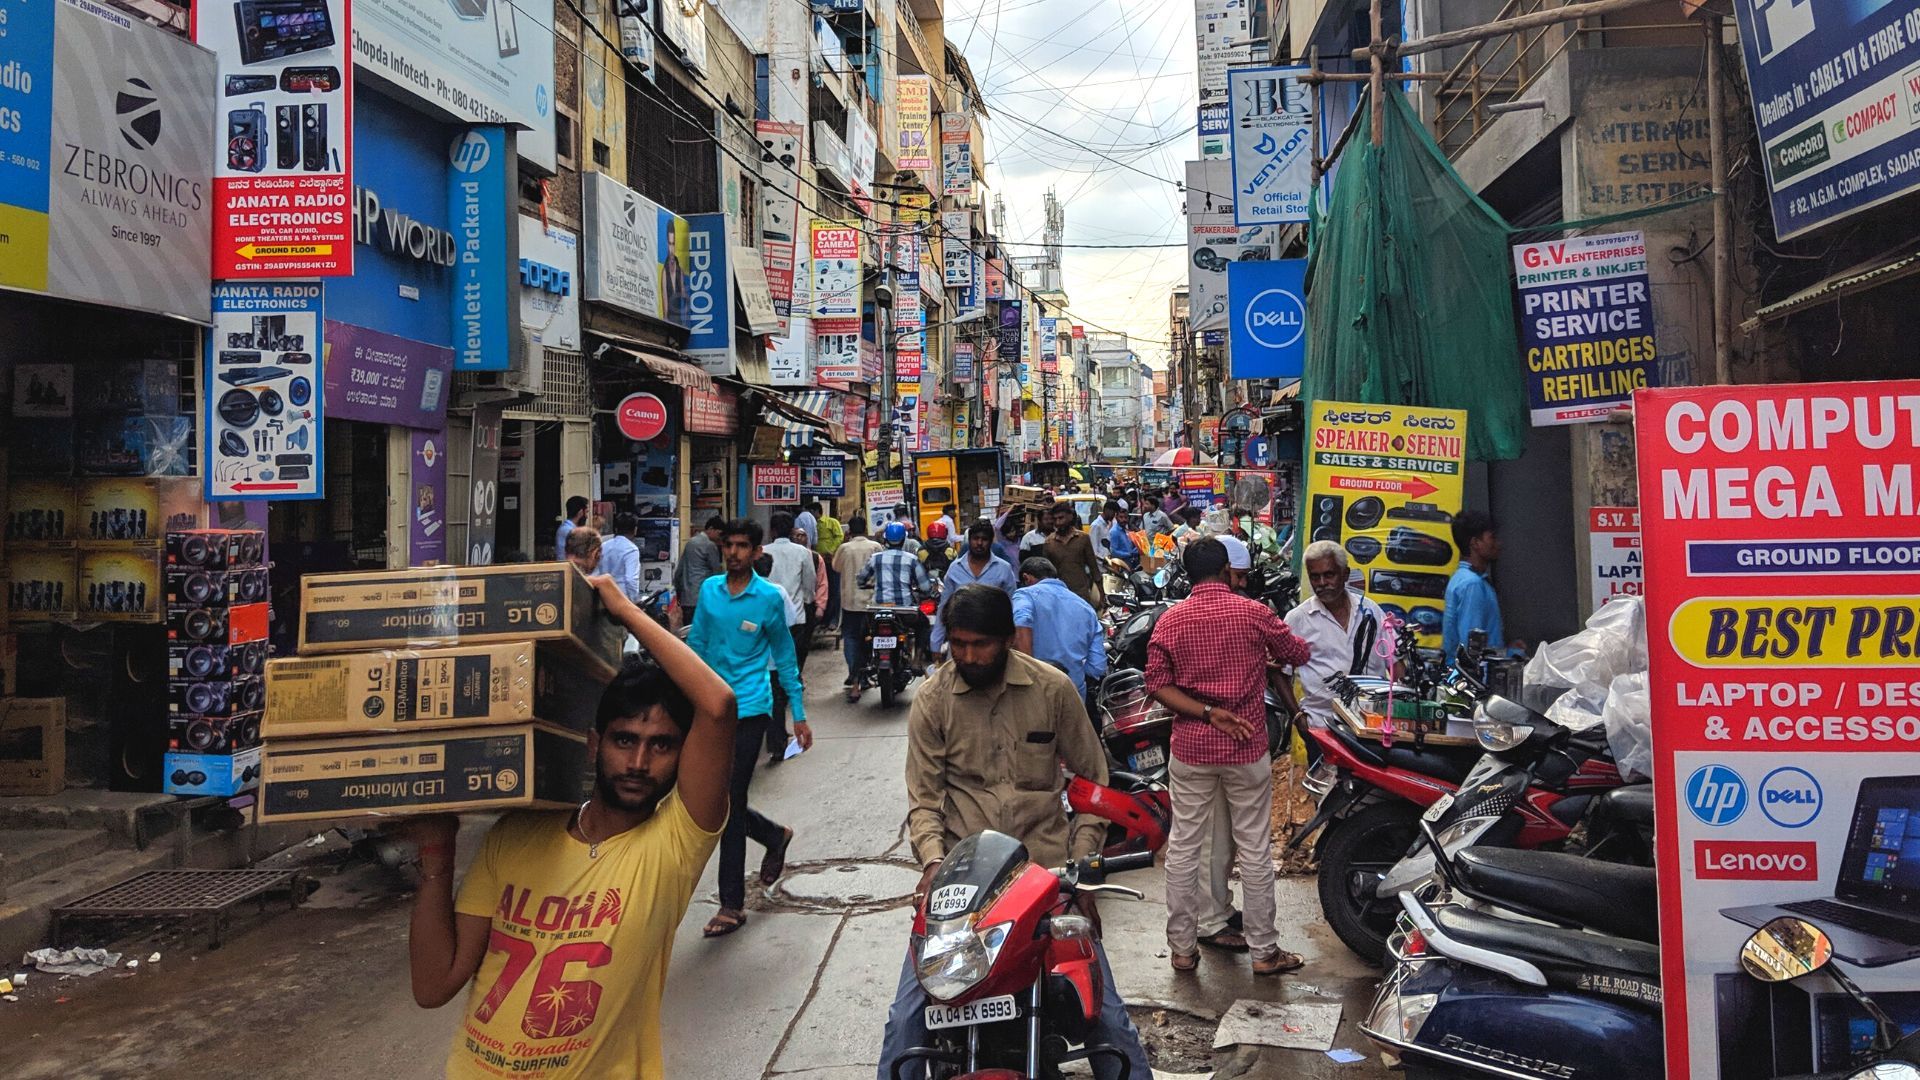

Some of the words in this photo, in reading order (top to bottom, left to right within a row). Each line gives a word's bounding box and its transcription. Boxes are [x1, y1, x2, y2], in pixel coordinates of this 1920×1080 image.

[352, 28, 388, 67] Chopda
[391, 51, 429, 90] Infotech
[437, 78, 451, 102] Ph:
[452, 88, 468, 110] 080
[469, 97, 488, 122] 4215
[1759, 92, 1794, 127] Dealers
[1792, 82, 1805, 109] in
[1810, 55, 1845, 99] CABLE
[1843, 48, 1858, 80] TV
[1858, 42, 1870, 72] &
[1868, 18, 1906, 66] FIBRE
[896, 88, 928, 96] S.M.D
[1201, 109, 1229, 119] PRINT
[1846, 92, 1897, 139] COMPACT
[1202, 121, 1229, 130] SERV
[451, 132, 490, 173] hp
[1780, 133, 1824, 166] CONCORD
[12, 156, 26, 166] 560
[26, 158, 40, 170] 002
[1242, 128, 1309, 195] VENTION
[64, 143, 202, 211] ZEBRONICS
[1263, 192, 1302, 202] Official
[1796, 196, 1810, 215] 82,
[1810, 183, 1838, 208] N.G.M.
[1838, 164, 1887, 198] COMPLEX,
[81, 188, 138, 216] ALWAYS
[143, 204, 187, 228] AHEAD
[227, 194, 290, 208] JANATA
[294, 194, 346, 207] RADIO
[1252, 206, 1282, 216] Retail
[1286, 206, 1308, 214] Stor
[229, 212, 344, 226] ELECTRONICS
[352, 184, 380, 246] HP
[383, 208, 456, 268] WORLD
[461, 182, 480, 264] Packard
[112, 225, 139, 243] Since
[140, 232, 161, 248] 1997
[612, 222, 648, 252] ZEBRONICS
[817, 230, 856, 241] CCTV
[1523, 244, 1571, 268] G.V.
[1572, 246, 1645, 263] ENTERPRISES
[519, 258, 570, 296] HOPDA
[689, 231, 714, 334] EPSON
[1520, 270, 1578, 285] PRINTER
[1582, 267, 1592, 277] &
[1596, 260, 1646, 276] INKJET
[212, 286, 270, 298] JANATA
[273, 286, 319, 298] RADIO
[620, 276, 637, 293] Electro
[638, 282, 655, 298] Centre
[222, 299, 308, 309] ELECTRONICS
[1524, 282, 1647, 315] PRINTER
[777, 308, 789, 316] INC.
[1253, 311, 1300, 326] DELL
[462, 283, 481, 364] Hewlett
[1536, 308, 1642, 340] SERVICE
[1528, 335, 1655, 372] CARTRIDGES
[1542, 368, 1647, 402] REFILLING
[625, 408, 660, 420] Canon
[1323, 410, 1392, 426] ಸ್ಪೀಕರ್
[1403, 415, 1455, 430] ಸೀನು
[1563, 411, 1578, 419] 1st
[1257, 443, 1267, 456] P
[1315, 428, 1389, 452] SPEAKER
[1406, 433, 1460, 458] SEENU
[1322, 453, 1366, 467] SALES
[1372, 457, 1382, 468] &
[1388, 458, 1452, 473] SERVICE
[1340, 478, 1374, 489] GROUND
[1376, 480, 1402, 490] FLOOR
[1661, 464, 1843, 520] MEGA
[1598, 513, 1626, 527] S.V.
[1736, 548, 1841, 567] GROUND
[1848, 546, 1920, 564] FLOOR
[1598, 565, 1642, 578] LAPT
[460, 587, 478, 598] LED
[382, 612, 449, 628] Monitor
[454, 611, 486, 627] LED
[508, 607, 532, 623] LG
[1705, 606, 1836, 660] BEST
[368, 667, 382, 692] LG
[396, 660, 408, 698] Monitor
[422, 695, 430, 712] LED
[1676, 682, 1823, 707] LAPTOP
[396, 701, 408, 721] LED
[1704, 716, 1732, 741] &
[341, 782, 408, 799] Monitor
[413, 779, 445, 796] LED
[468, 774, 492, 791] LG
[1690, 765, 1745, 826] hp
[1766, 789, 1816, 804] DELL
[1704, 849, 1808, 871] Lenovo
[938, 888, 950, 898] KA
[954, 887, 966, 896] 04
[496, 884, 622, 931] ALOHA
[932, 900, 944, 912] EX
[944, 898, 967, 909] 6993
[502, 922, 516, 933] TAKE
[521, 927, 530, 936] ME
[536, 931, 545, 939] TO
[550, 931, 564, 940] THE
[568, 930, 593, 939] BEACH
[474, 929, 612, 1039] 76
[1593, 975, 1612, 987] K.H.
[1614, 978, 1639, 991] ROAD
[928, 1009, 944, 1025] KA
[946, 1008, 960, 1022] 04
[964, 1005, 978, 1020] EX
[982, 1001, 1012, 1018] 6993
[464, 1014, 505, 1051] Summer
[509, 1038, 593, 1057] Paradise
[465, 1037, 570, 1072] SEA-SUN-SURFING
